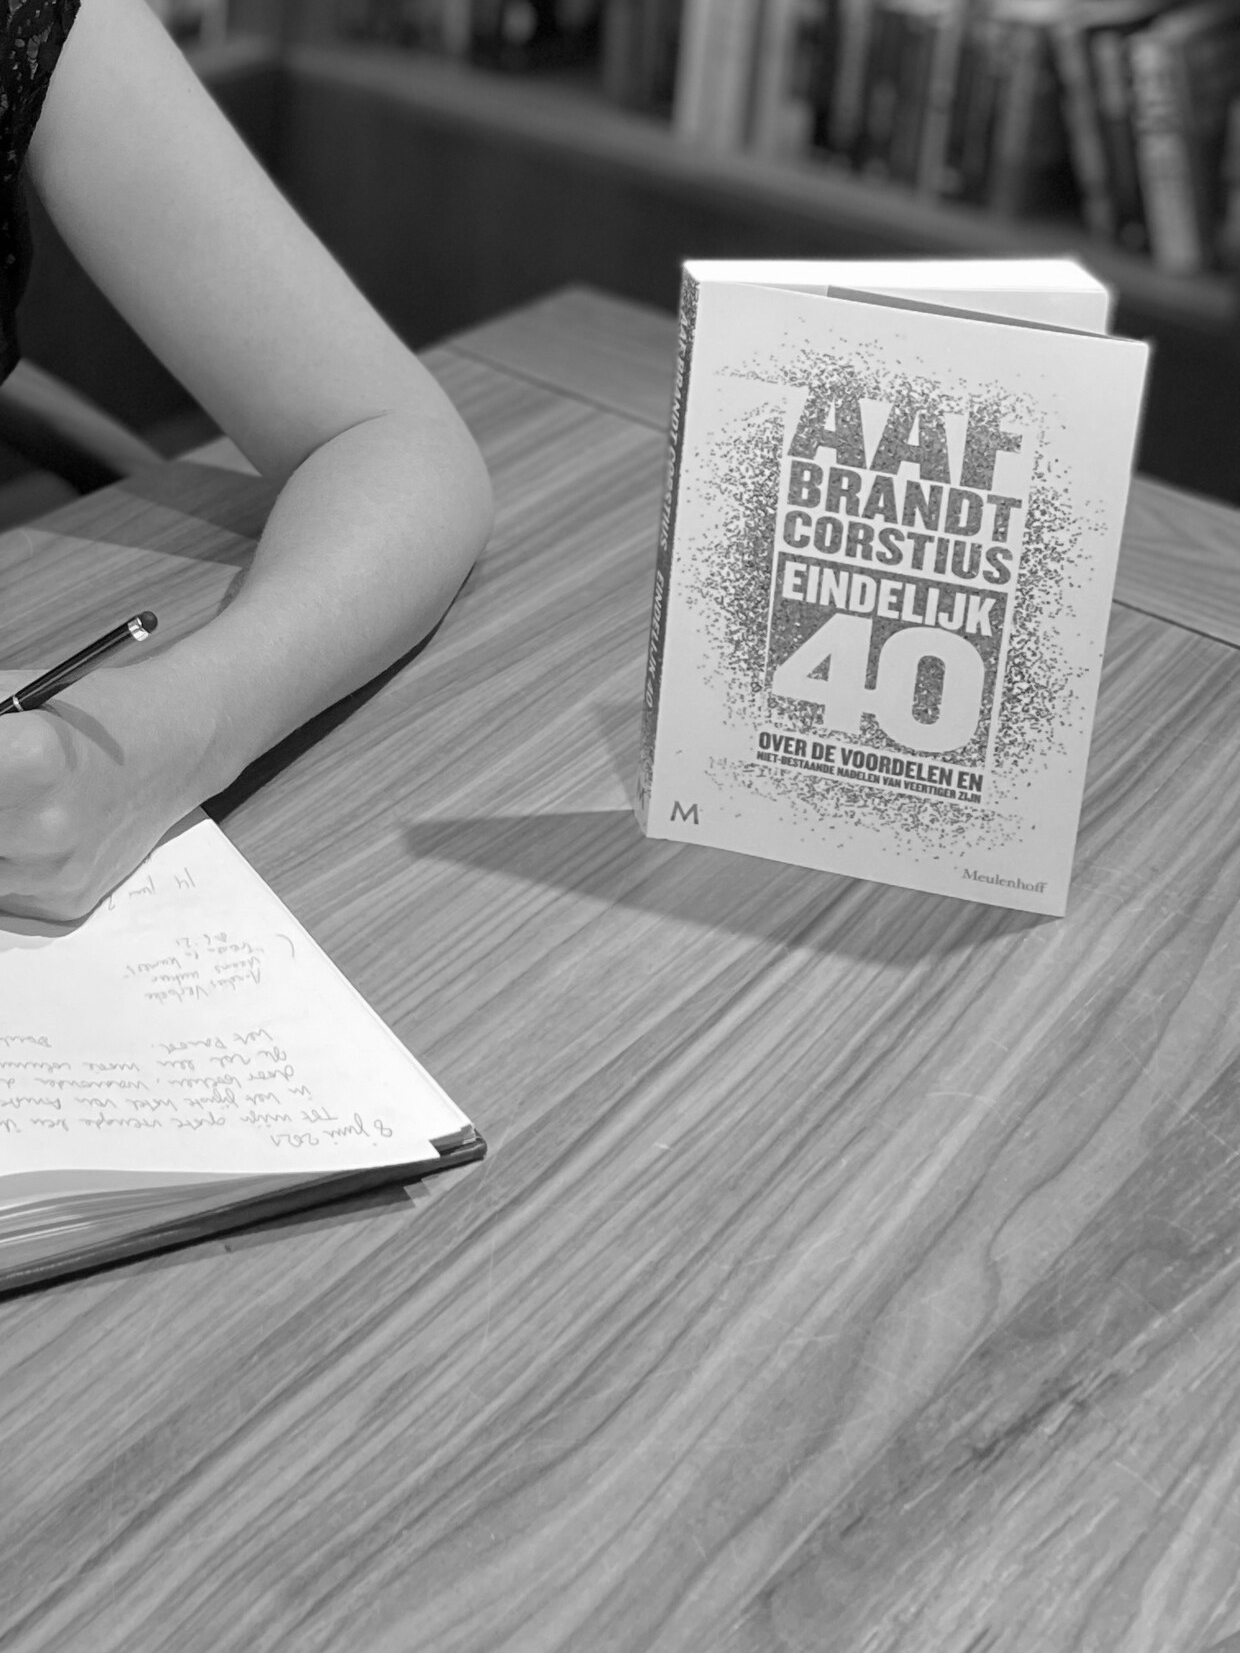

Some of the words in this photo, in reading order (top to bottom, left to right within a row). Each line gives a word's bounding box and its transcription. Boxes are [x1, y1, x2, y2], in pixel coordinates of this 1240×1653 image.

[669, 358, 685, 446] BRANDT
[787, 368, 1022, 491] AAF
[787, 459, 1023, 542] BRANDT
[783, 510, 1013, 585] CORSTIUS
[648, 570, 665, 680] EINDELIJK
[782, 560, 997, 637] EINDELIJK
[772, 613, 985, 753] 40
[756, 751, 835, 775] NIET-BESTAANDE
[837, 767, 880, 784] NADELEN
[882, 776, 902, 788] VAN
[904, 780, 956, 799] VEERTIGER
[958, 791, 981, 804] ZIJN
[759, 731, 807, 757] OVER
[811, 742, 837, 763] DE
[841, 747, 953, 786] VOORDELEN
[957, 771, 983, 792] EN
[670, 801, 699, 825] M
[962, 868, 1048, 894] Meulenhoff
[245, 1091, 281, 1106] het
